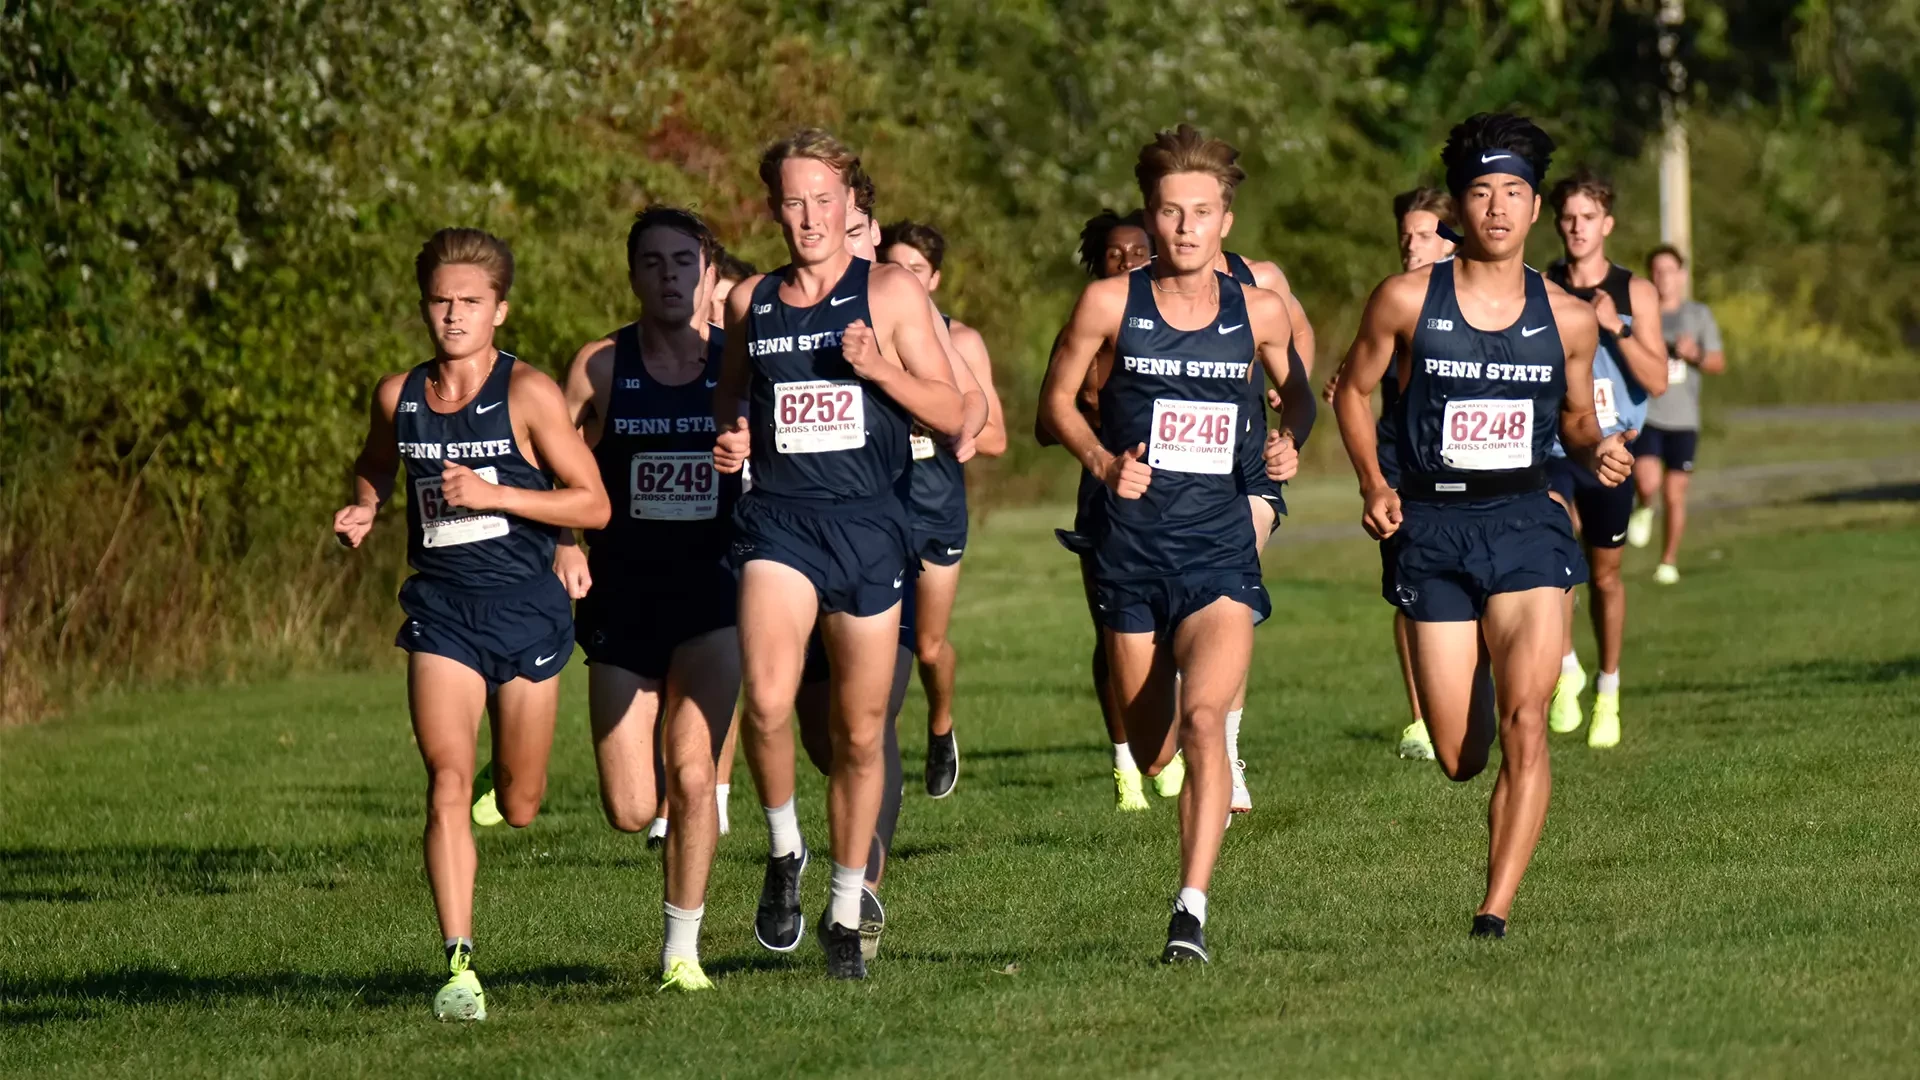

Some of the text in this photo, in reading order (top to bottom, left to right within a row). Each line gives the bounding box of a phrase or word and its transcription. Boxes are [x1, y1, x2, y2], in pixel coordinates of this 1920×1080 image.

[748, 331, 843, 357] PENN STA
[1123, 356, 1249, 379] PENN STATE
[1424, 358, 1553, 382] PENN STATE
[780, 391, 855, 425] 6252
[614, 416, 717, 435] PENN STA
[778, 423, 856, 434] CROSS COUNTRY
[1158, 411, 1230, 445] 6246
[1451, 411, 1526, 442] 6248
[446, 439, 511, 459] STATE
[1155, 442, 1228, 454] CROSS COUNTRY
[1447, 441, 1525, 450] CROSS COUNTRY
[637, 462, 712, 493] 6249
[668, 494, 712, 502] COUNTRY
